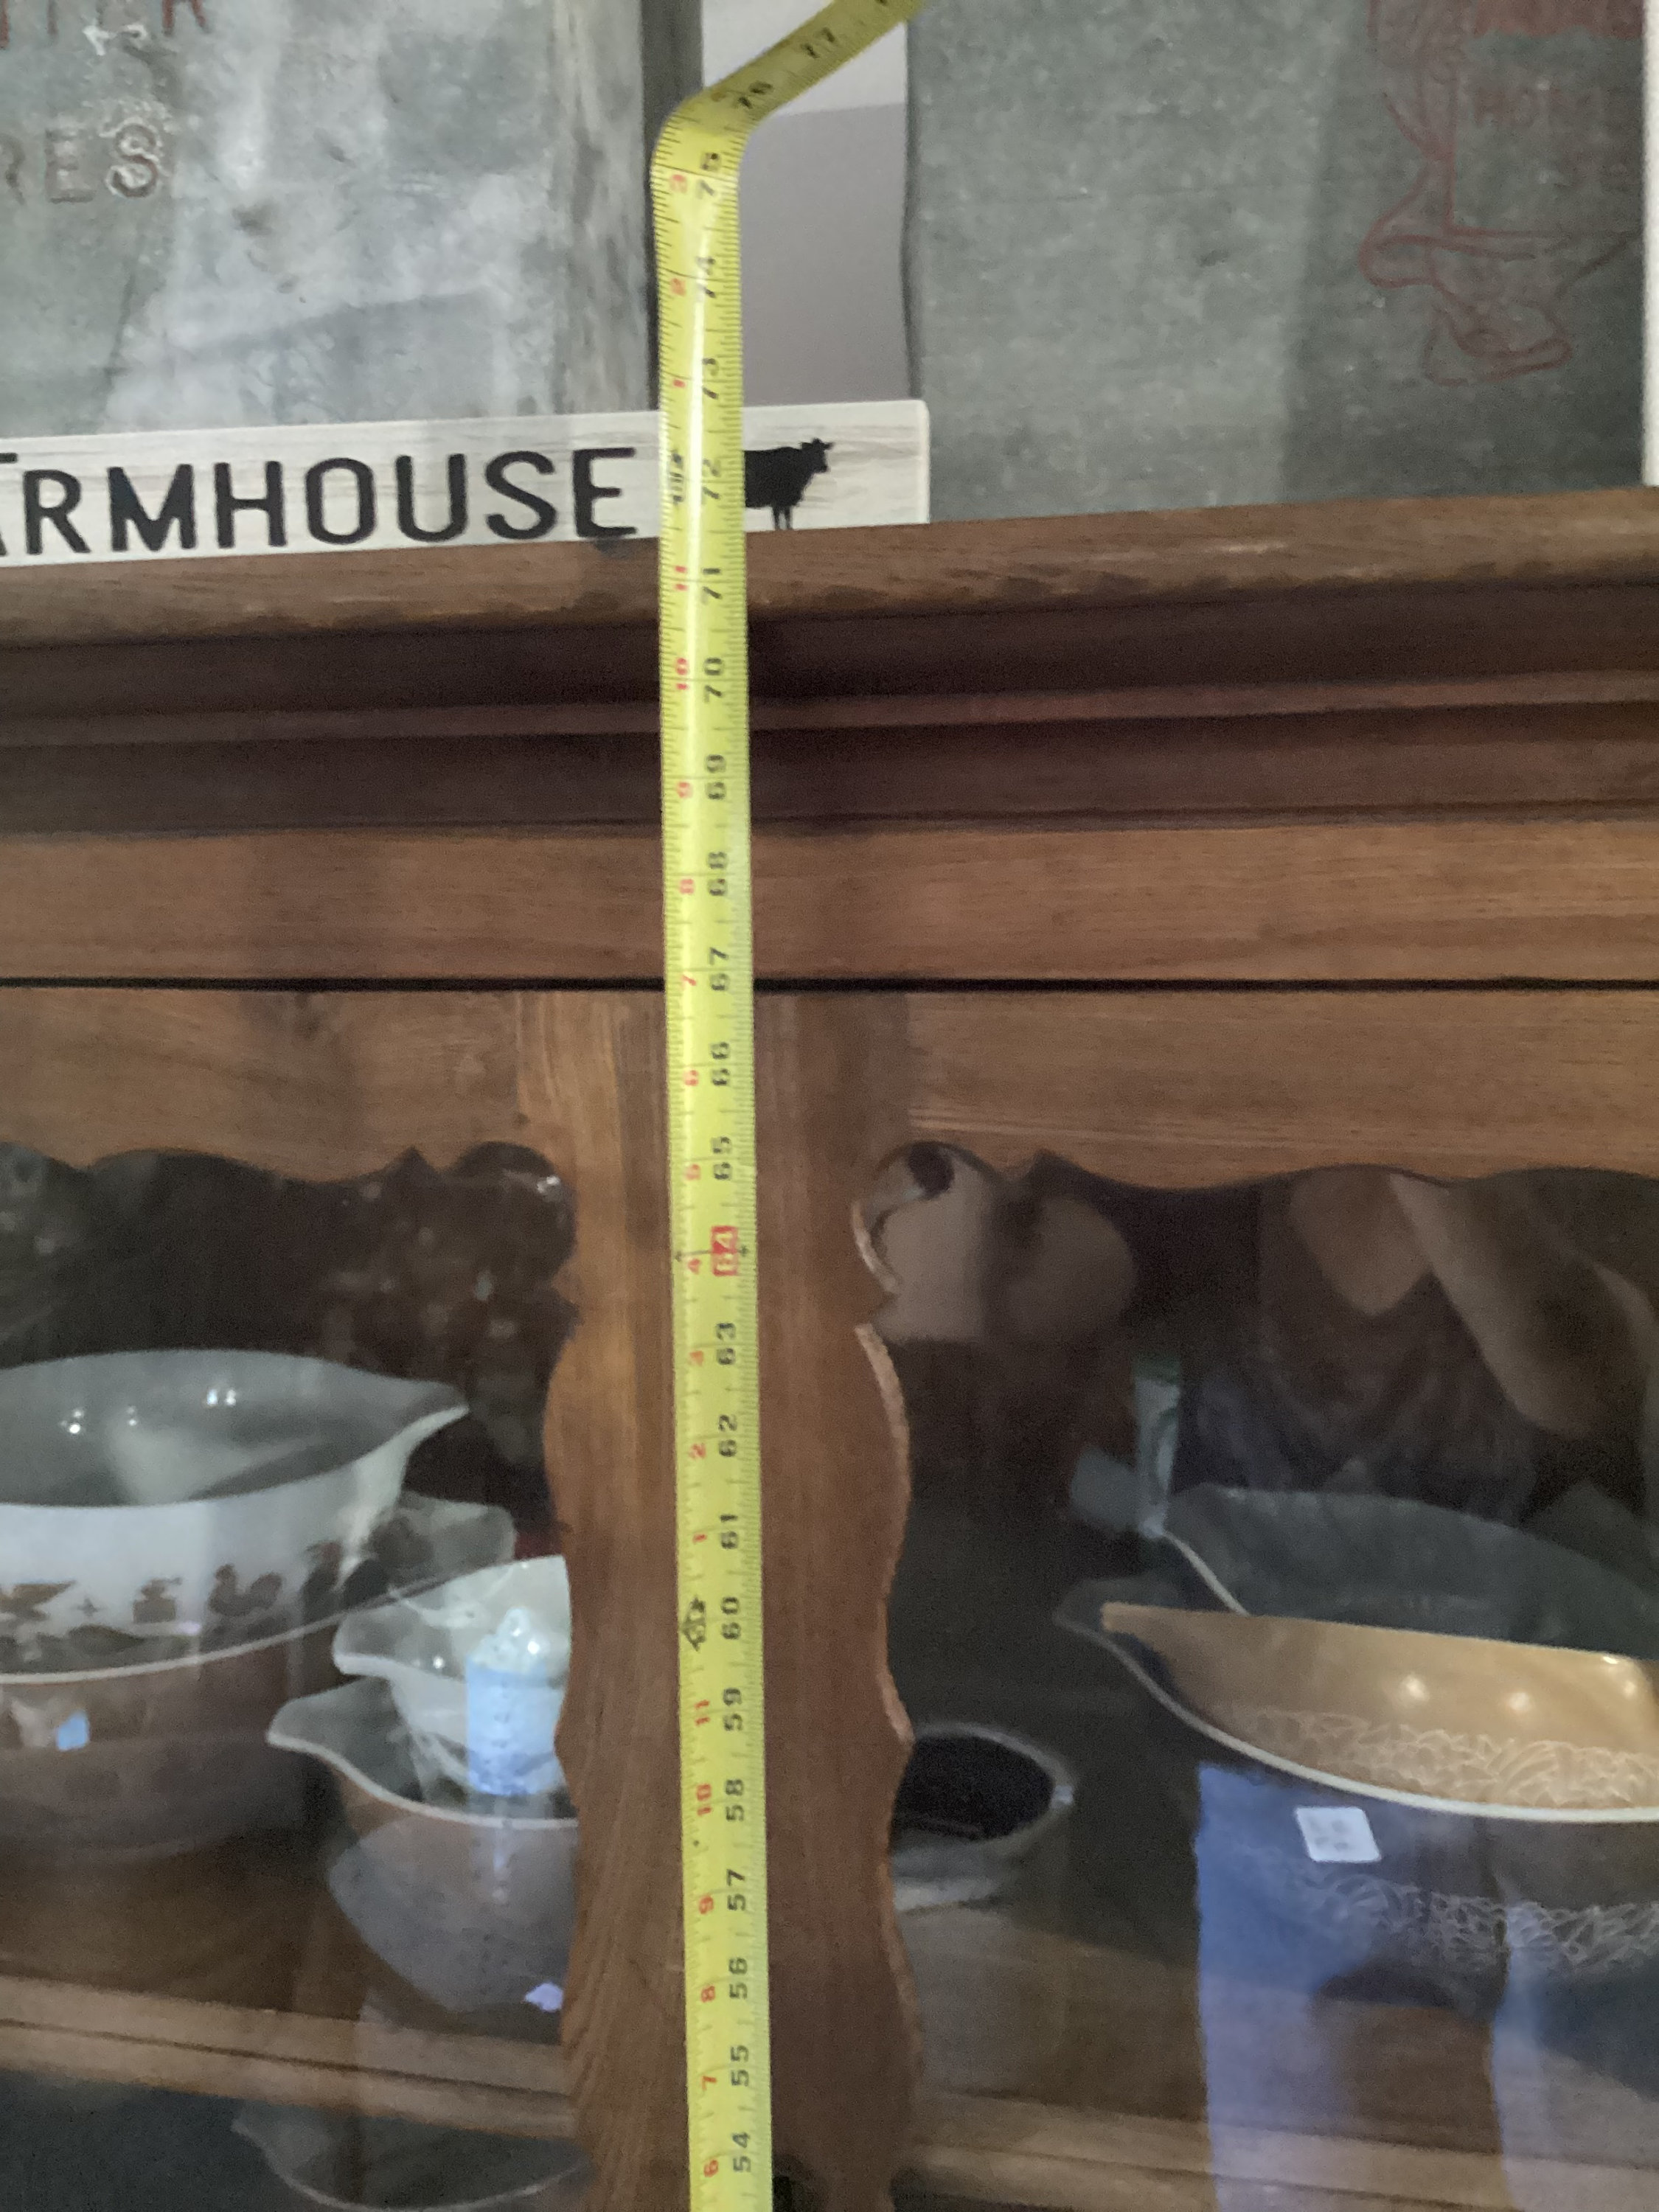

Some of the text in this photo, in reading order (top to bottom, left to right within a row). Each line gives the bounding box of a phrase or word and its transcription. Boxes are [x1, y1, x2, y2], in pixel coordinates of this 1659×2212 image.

[0, 447, 638, 556] RMHOUSE
[675, 657, 689, 690] 10
[704, 657, 723, 702] 70
[706, 754, 726, 800] 69
[707, 851, 728, 896] 68
[709, 947, 728, 991] 67
[709, 1041, 730, 1086] 66
[711, 1136, 732, 1180] 65
[713, 1227, 737, 1274] 64
[718, 1413, 737, 1458] 62
[719, 1514, 738, 1549] 61
[721, 1597, 740, 1640] 60
[694, 1699, 710, 1726] 11
[722, 1687, 743, 1731] 59
[696, 1783, 712, 1816] 10
[724, 1778, 745, 1822] 58
[698, 1895, 714, 1915] 9
[726, 1868, 746, 1912] 57
[700, 1984, 716, 2003] 8
[728, 1956, 748, 2000] 56
[701, 2074, 717, 2091] 7
[730, 2045, 750, 2087] 55
[731, 2132, 752, 2173] 54
